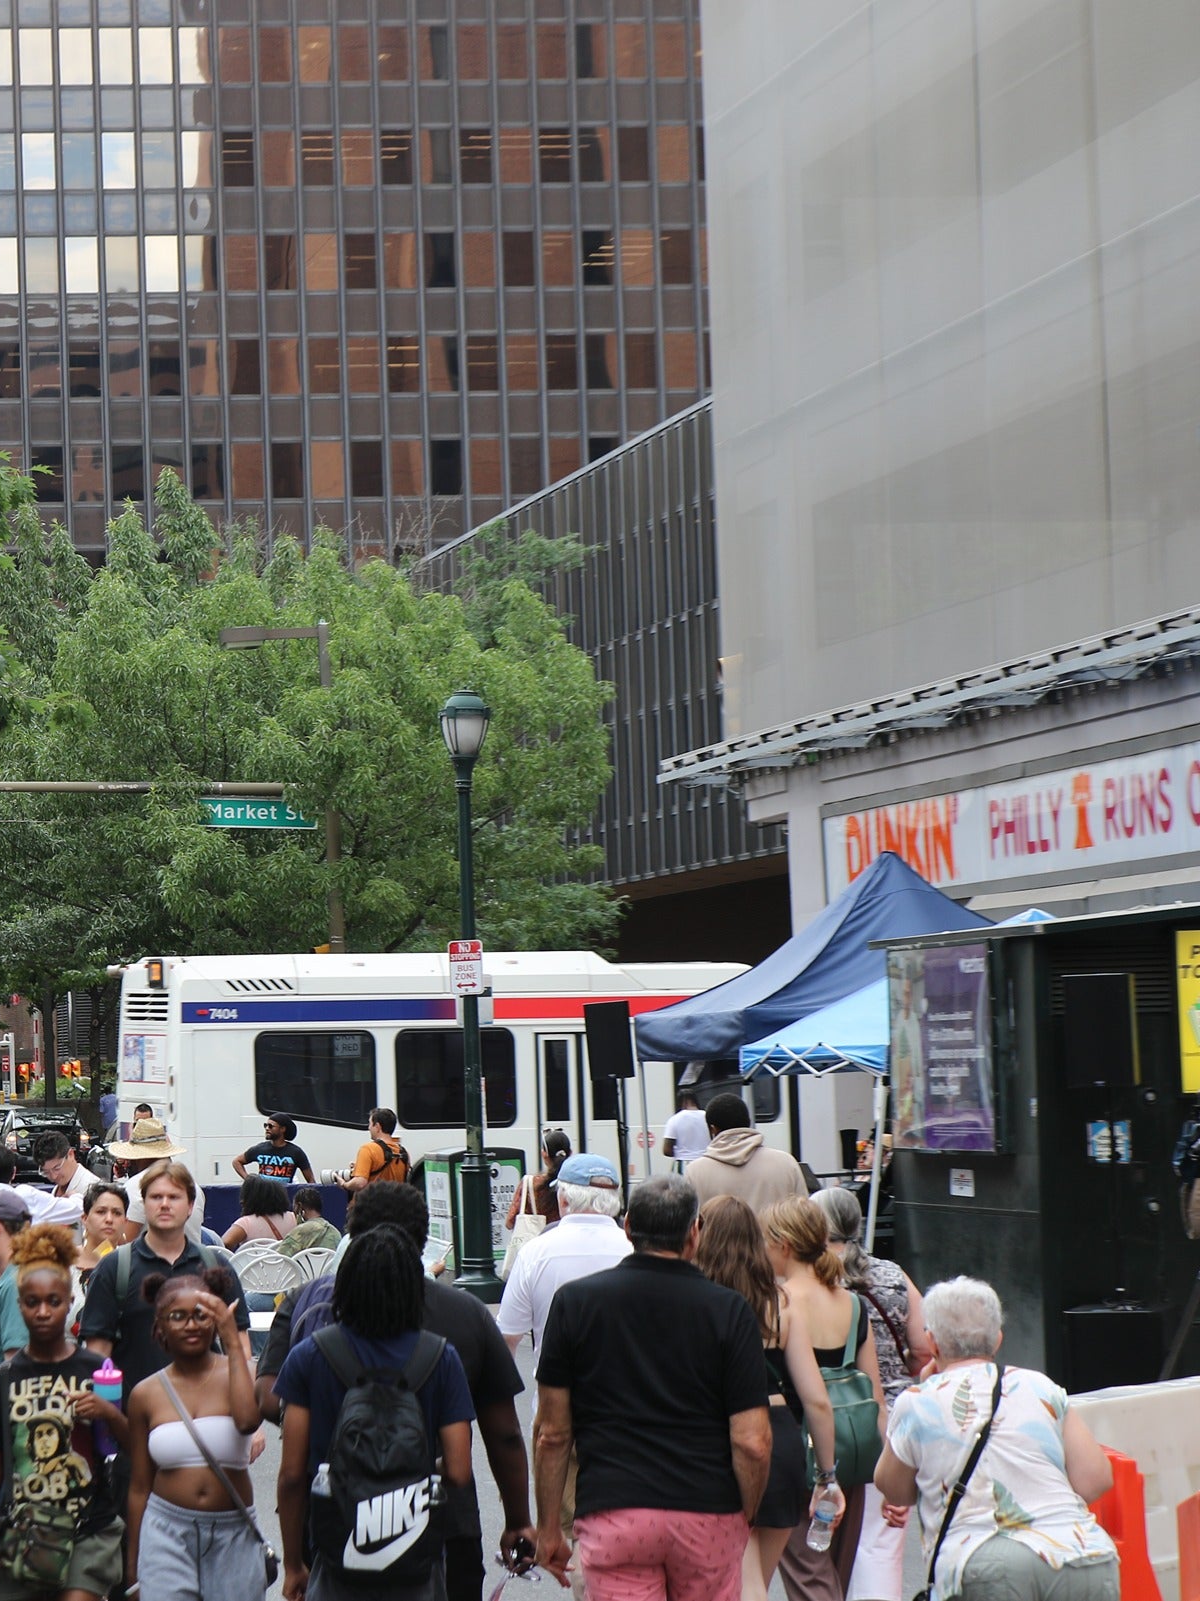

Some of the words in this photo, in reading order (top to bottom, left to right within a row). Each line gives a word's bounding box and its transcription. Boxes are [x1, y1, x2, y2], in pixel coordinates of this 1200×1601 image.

[209, 803, 277, 820] Market
[988, 788, 1063, 859] PHILLY
[1103, 767, 1173, 841] RUNS
[458, 942, 471, 953] NO
[450, 953, 481, 961] STOPPING
[457, 964, 474, 972] BUS
[455, 972, 478, 980] ZONE
[208, 1008, 238, 1020] 7404
[342, 1043, 359, 1052] RED
[257, 1154, 287, 1166] STAY
[356, 1477, 430, 1547] NIKE
